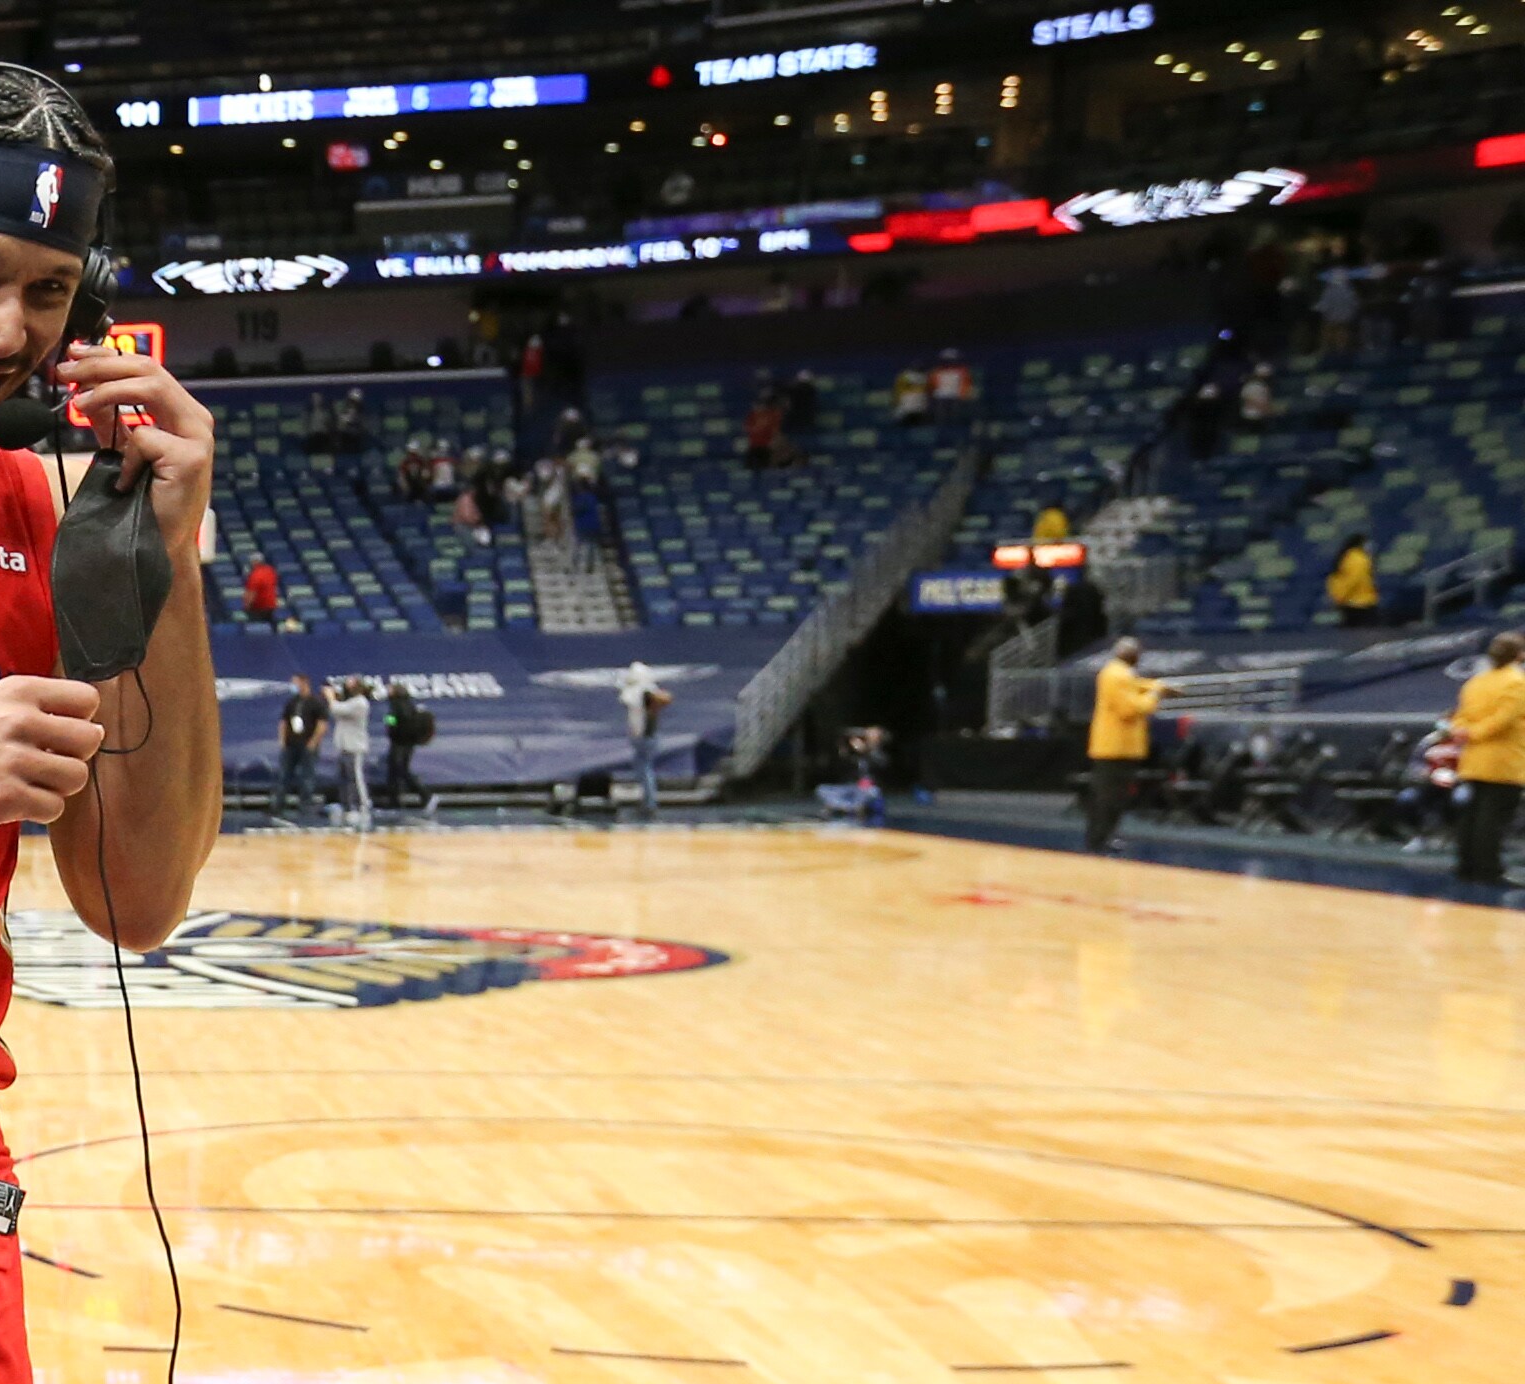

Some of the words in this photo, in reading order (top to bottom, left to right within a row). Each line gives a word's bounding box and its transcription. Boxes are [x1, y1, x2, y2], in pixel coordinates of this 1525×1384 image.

[1032, 3, 1155, 46] STEALS
[695, 53, 776, 86] TEAM
[776, 42, 877, 77] STATS:
[116, 101, 161, 127] 101
[236, 307, 280, 342] 119
